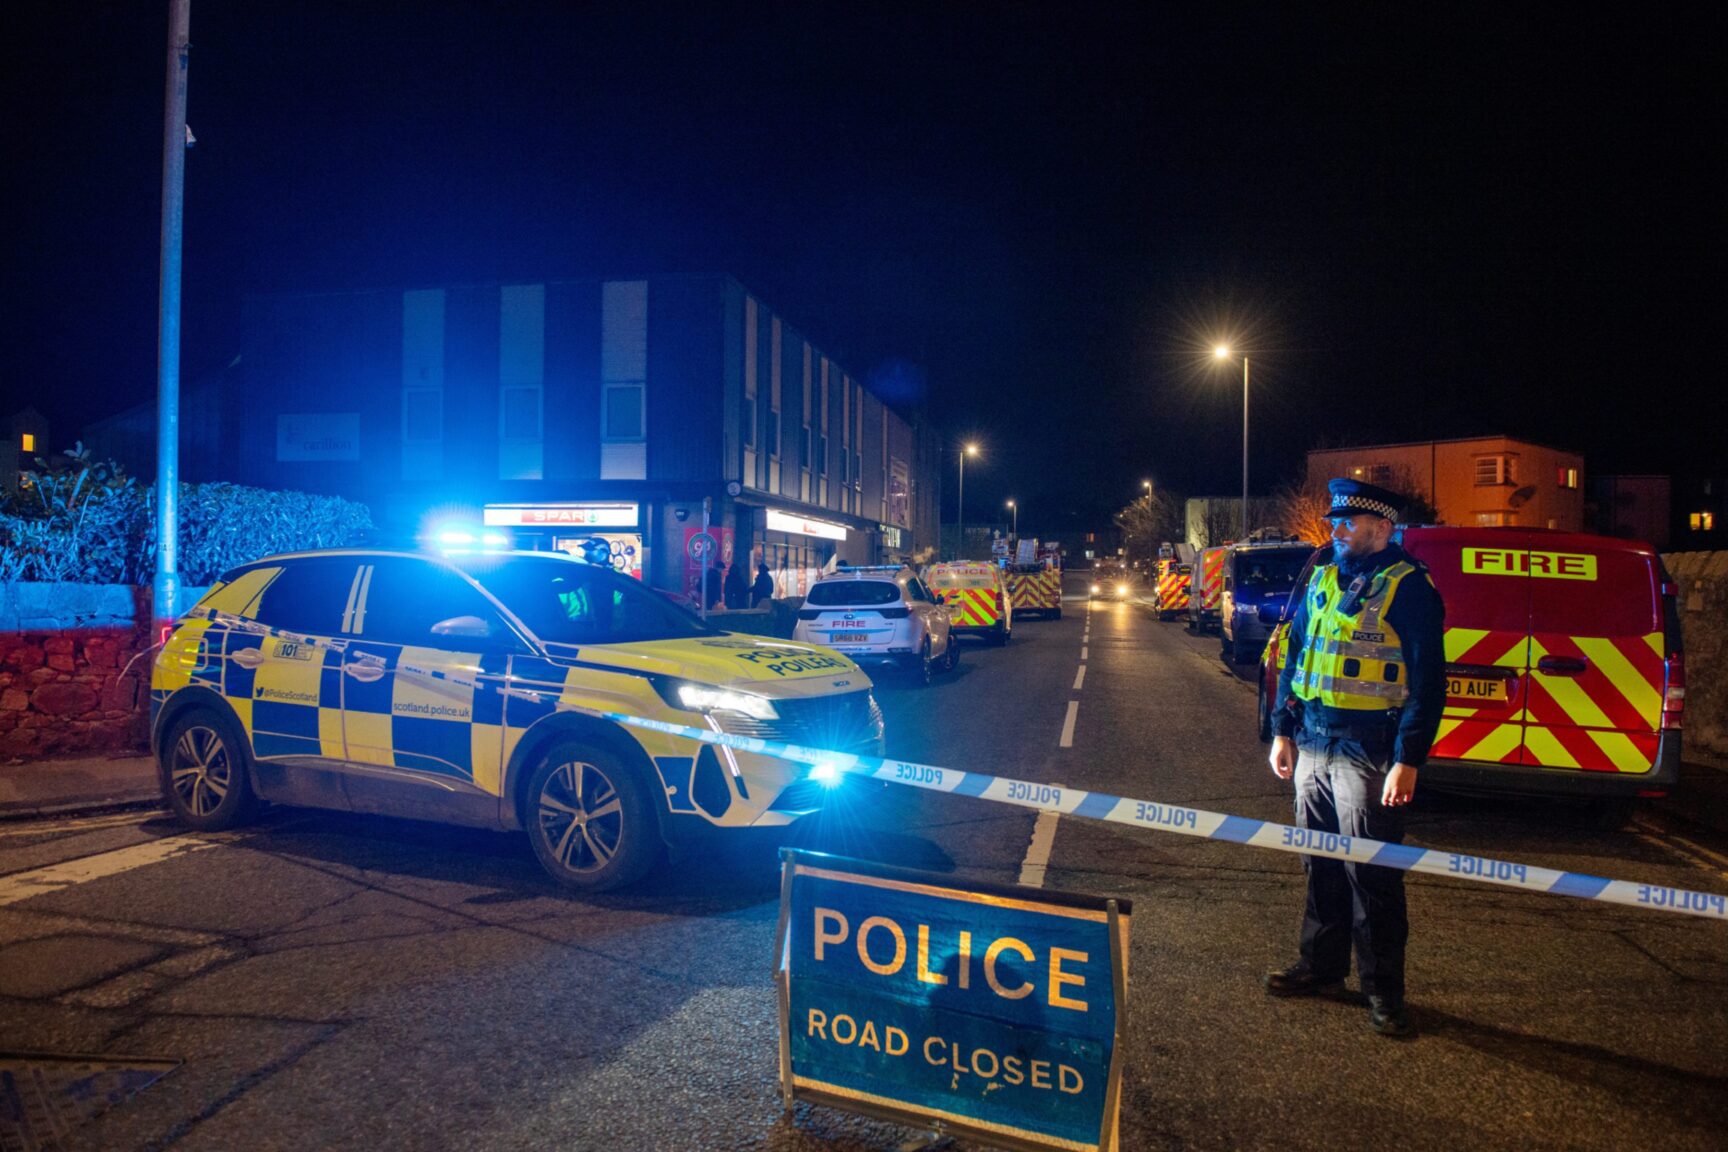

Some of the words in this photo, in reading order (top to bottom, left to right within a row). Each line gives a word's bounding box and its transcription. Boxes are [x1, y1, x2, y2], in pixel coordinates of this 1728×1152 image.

[533, 511, 585, 522] SPAR
[1473, 550, 1587, 577] FIRE
[936, 568, 989, 576] POLICE
[832, 620, 866, 628] FIRE
[1354, 632, 1383, 642] POLICE
[281, 643, 298, 657] 101
[1466, 681, 1498, 697] AUF
[393, 702, 470, 718] scotland.police.uk
[814, 907, 1089, 1012] POLICE
[807, 1008, 910, 1056] ROAD
[923, 1036, 1085, 1095] CLOSED
